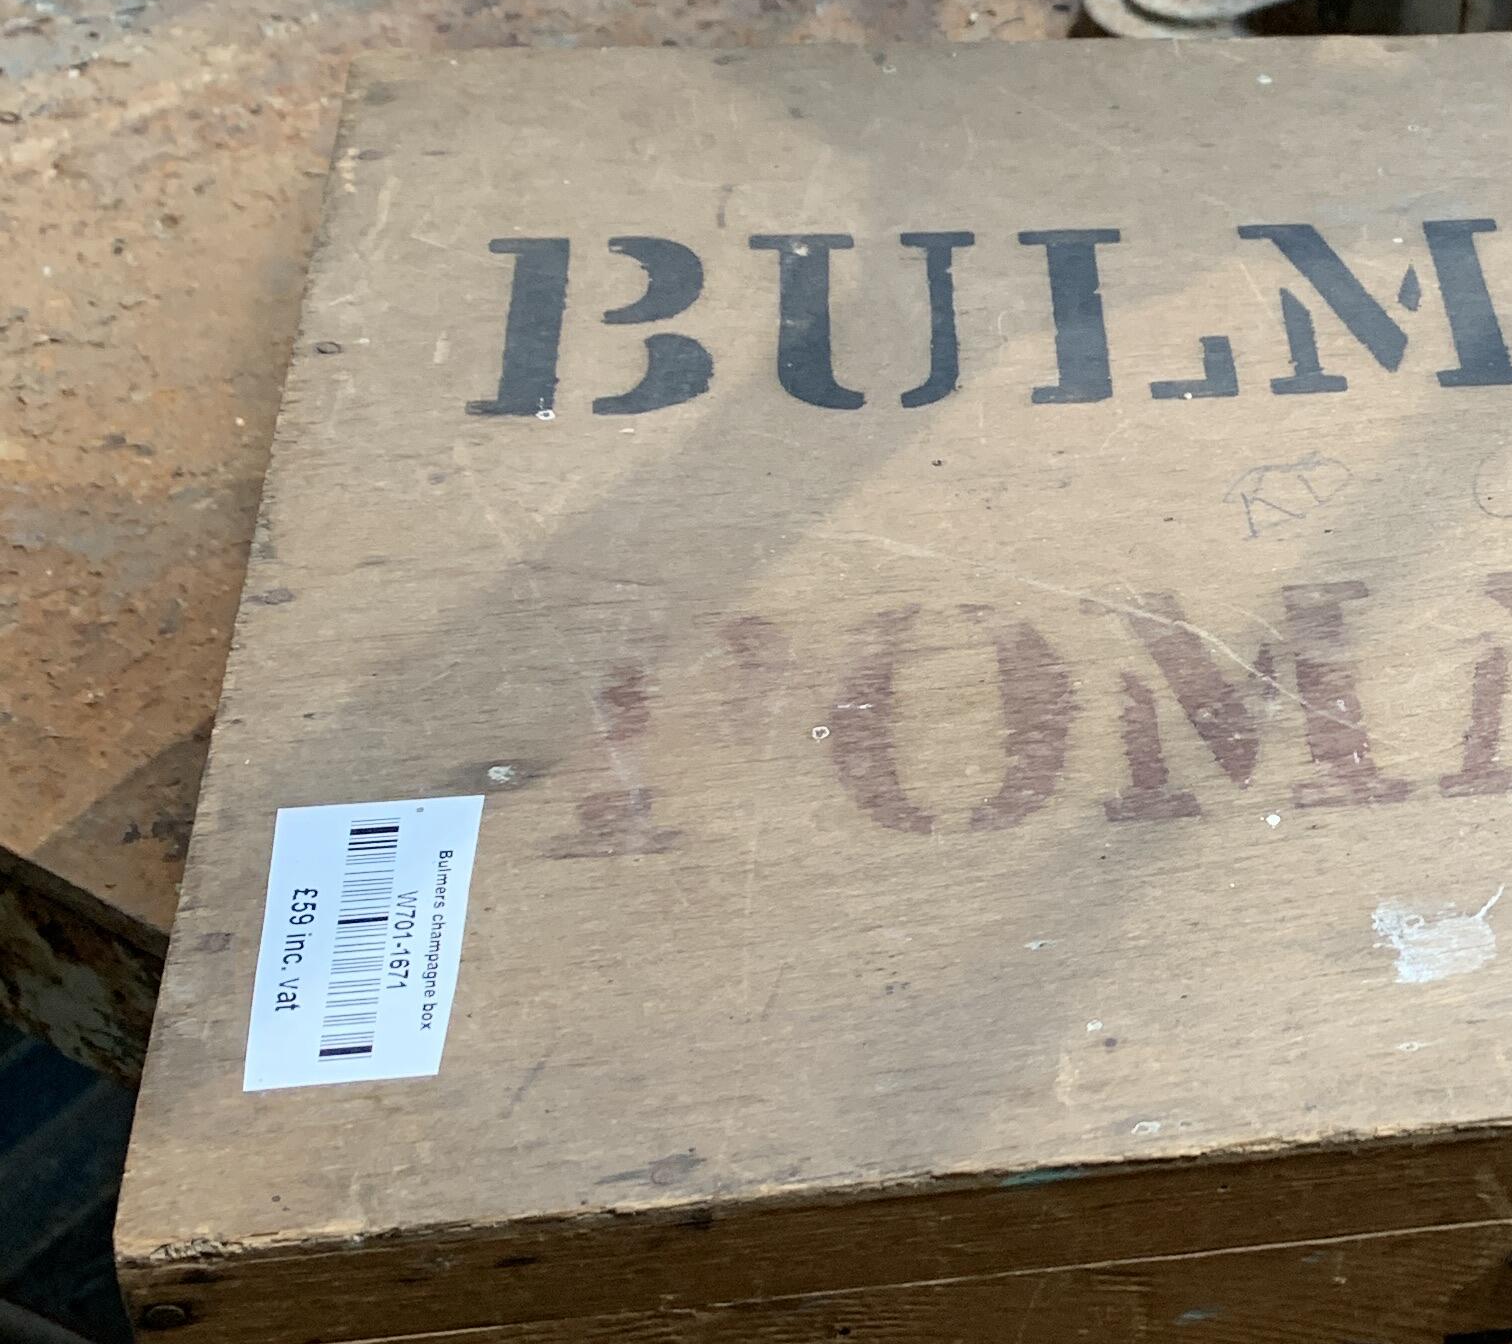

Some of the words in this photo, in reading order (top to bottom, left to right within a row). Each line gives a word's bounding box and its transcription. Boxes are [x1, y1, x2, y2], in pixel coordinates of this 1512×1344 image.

[432, 850, 454, 909] Bulmers
[289, 888, 319, 926] £59
[281, 932, 313, 971] inc.
[386, 890, 419, 990] W701-1671
[421, 913, 446, 998] champagne
[275, 977, 301, 1012] vat
[420, 1002, 438, 1031] box
